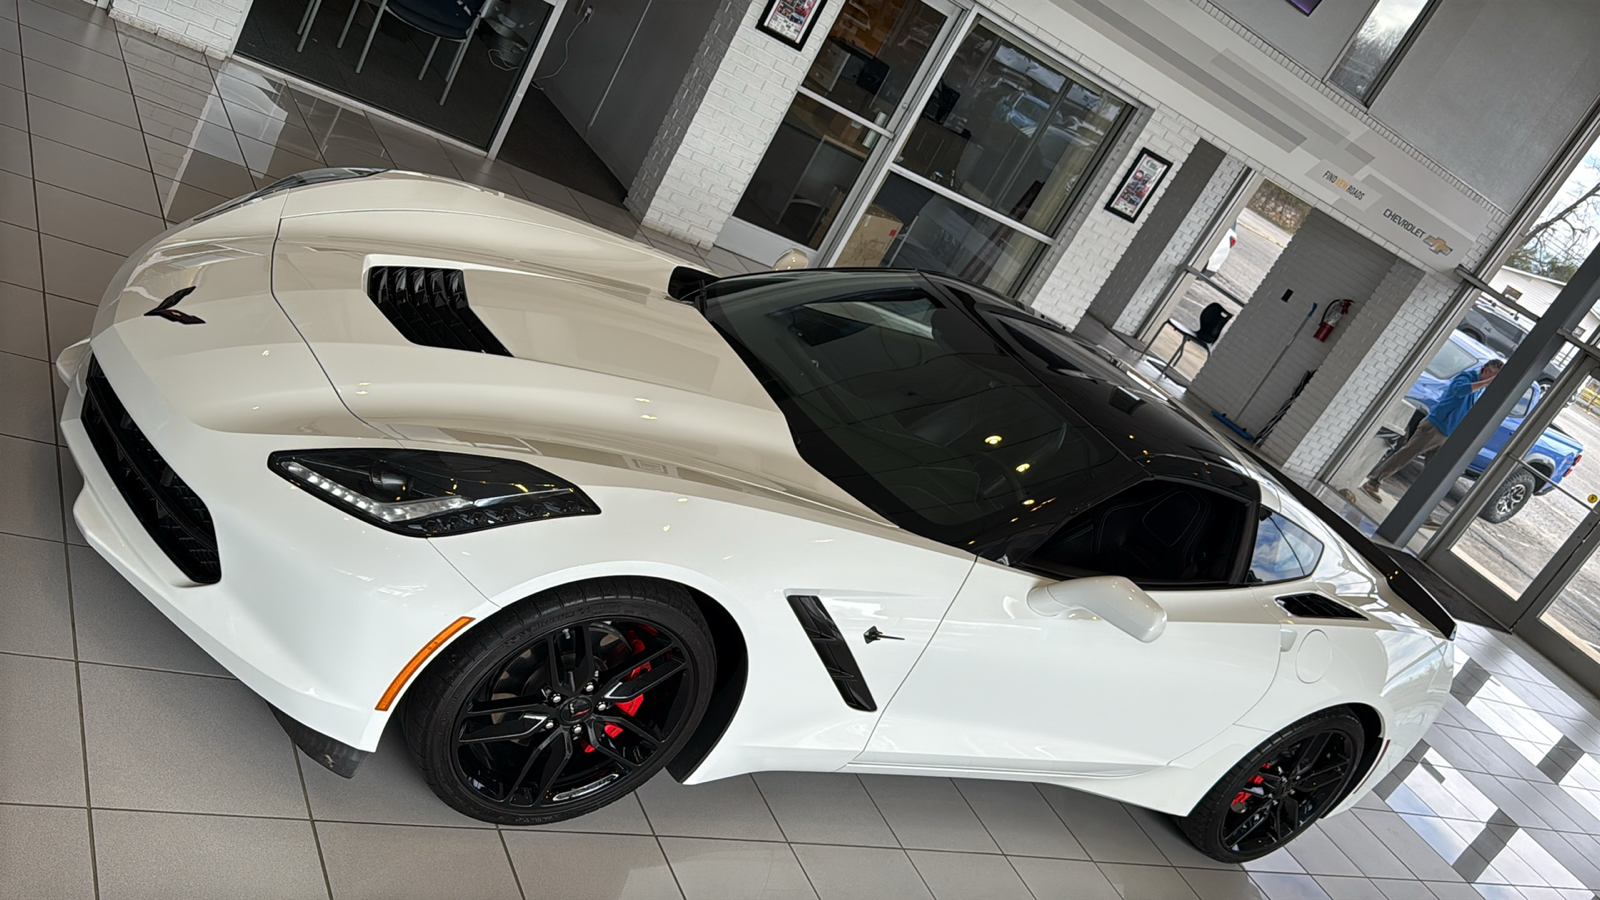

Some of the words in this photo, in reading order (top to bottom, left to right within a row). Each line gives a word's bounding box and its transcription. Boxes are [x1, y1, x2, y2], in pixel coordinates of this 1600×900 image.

[1322, 170, 1338, 184] FIND
[1334, 178, 1349, 190] NEW
[1346, 185, 1365, 201] ROADS
[1382, 208, 1426, 239] CHEVROLET
[530, 611, 575, 632] MICHELIN
